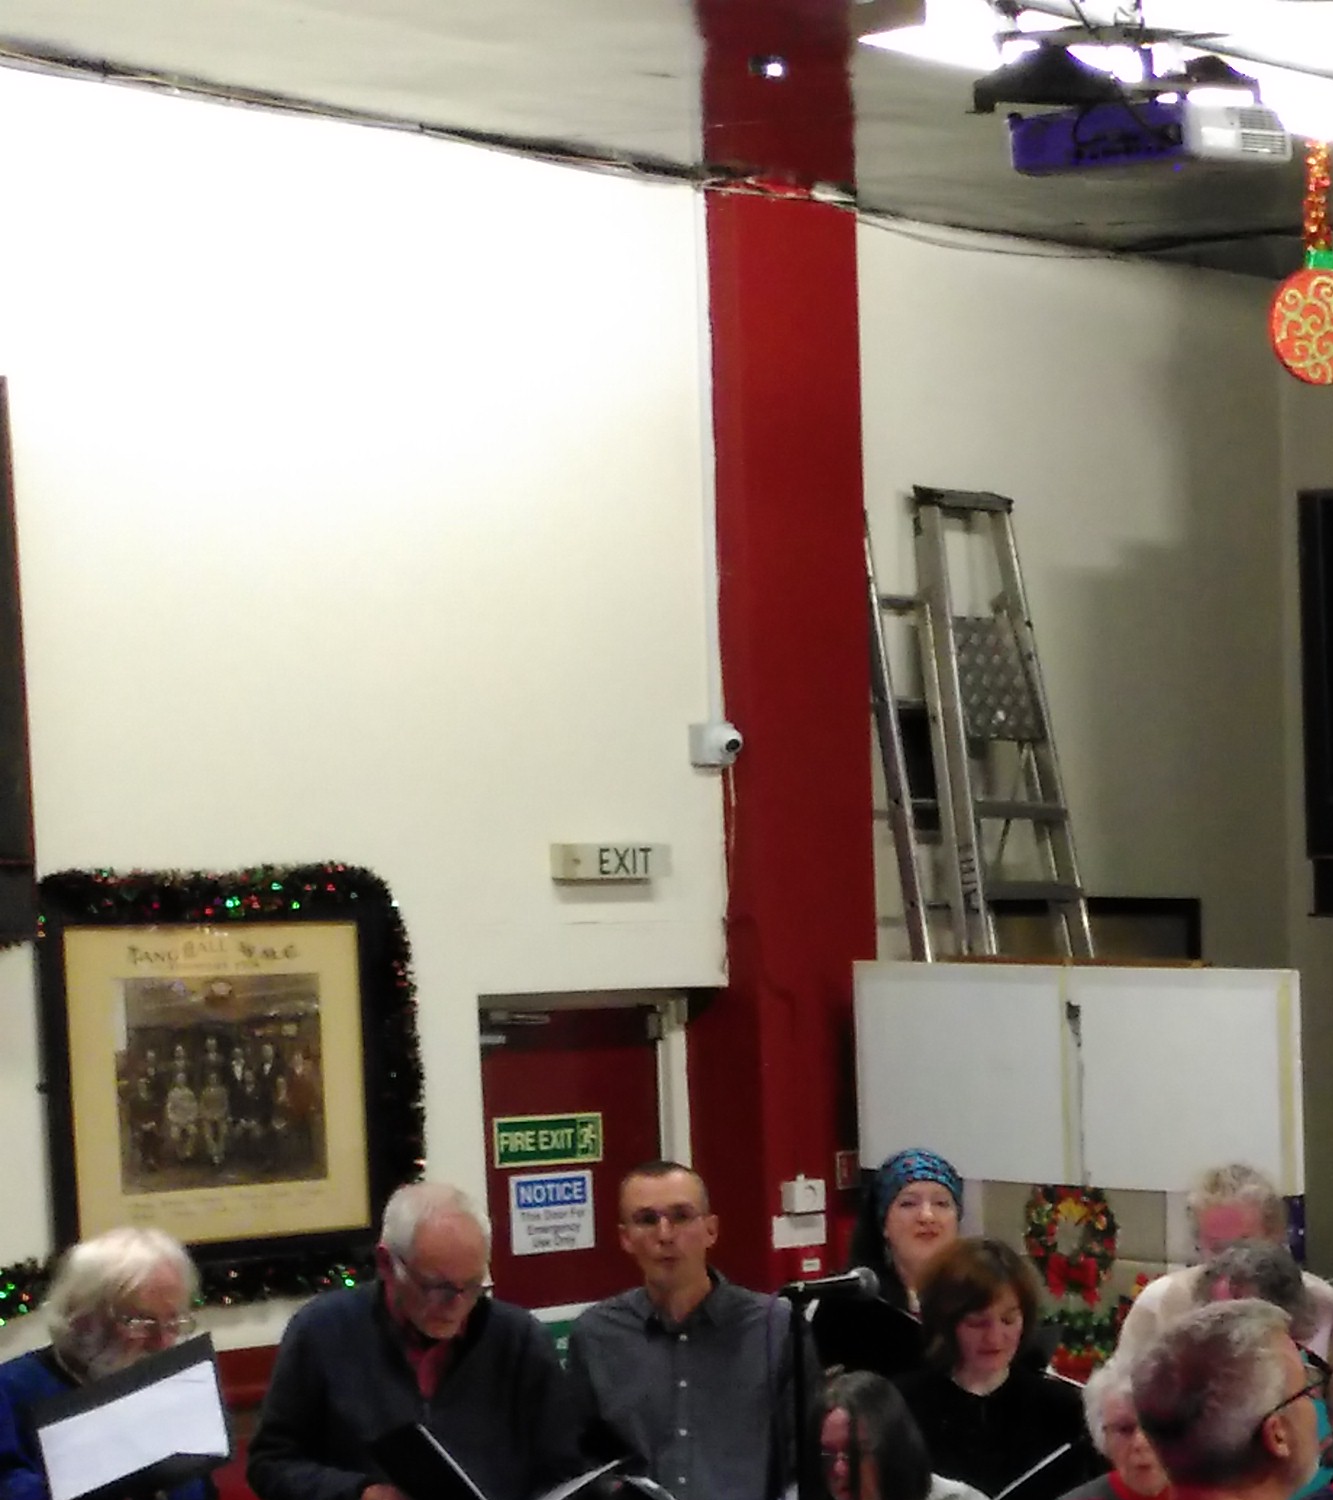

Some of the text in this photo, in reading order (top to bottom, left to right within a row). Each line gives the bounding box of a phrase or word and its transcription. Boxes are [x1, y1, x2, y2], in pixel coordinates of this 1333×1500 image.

[599, 847, 652, 875] EXIT
[500, 1128, 575, 1153] FIRE EXIT
[518, 1181, 584, 1204] NOTICE
